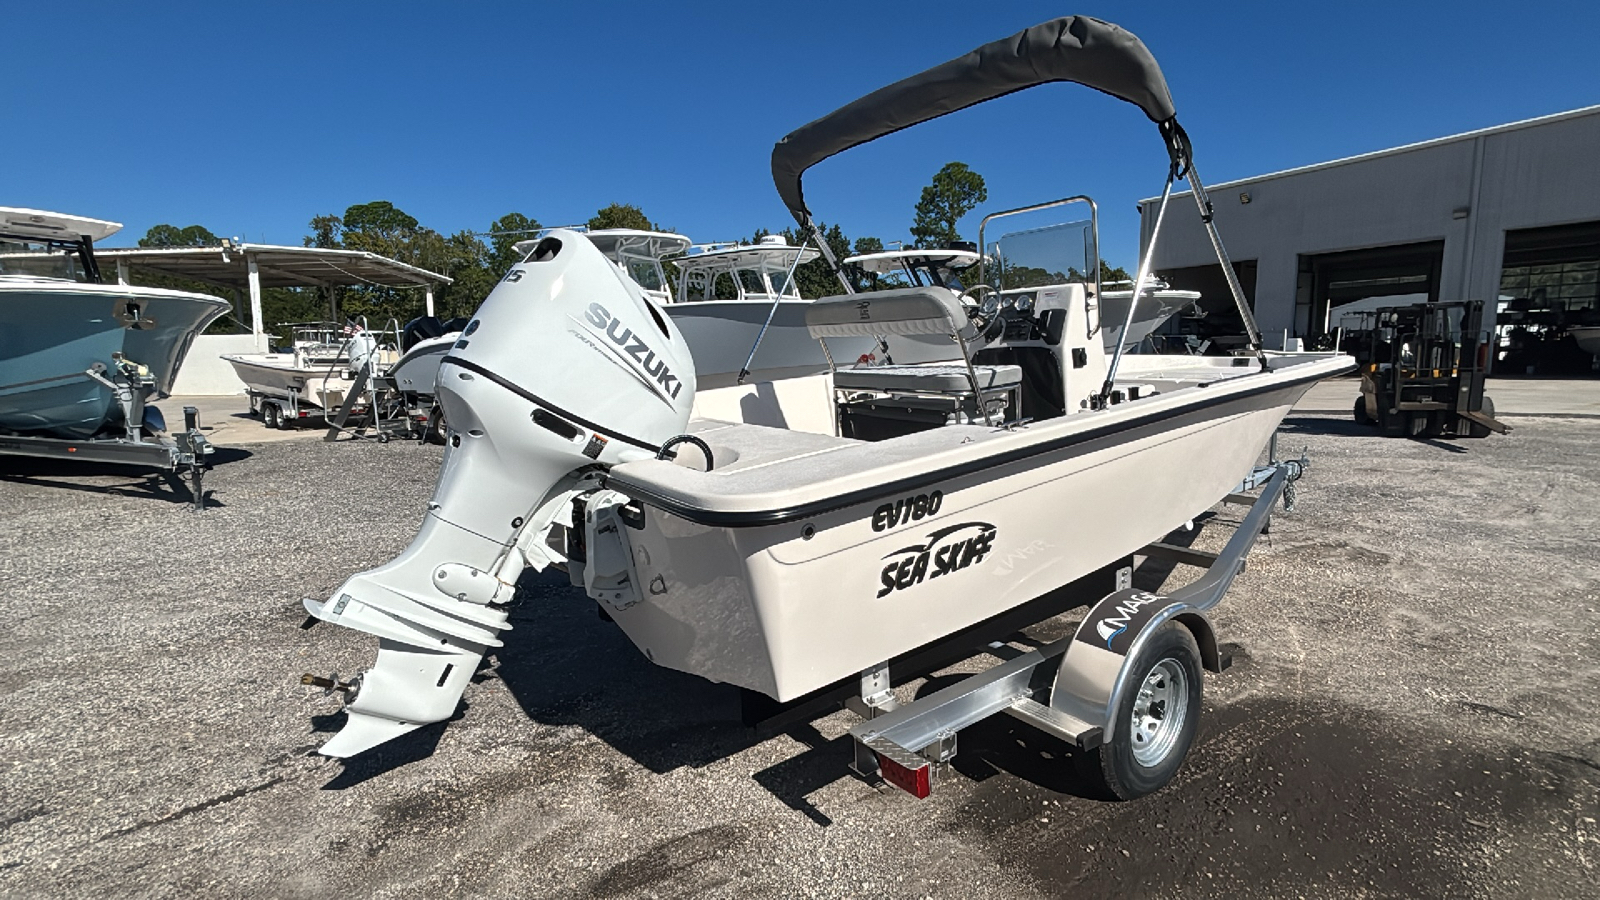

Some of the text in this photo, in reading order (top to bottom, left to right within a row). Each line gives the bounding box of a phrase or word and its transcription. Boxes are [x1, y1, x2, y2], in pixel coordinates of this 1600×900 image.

[584, 302, 682, 400] SUZUKI
[872, 489, 944, 533] EV180
[876, 551, 930, 599] SEA
[929, 529, 998, 580] SKIFF
